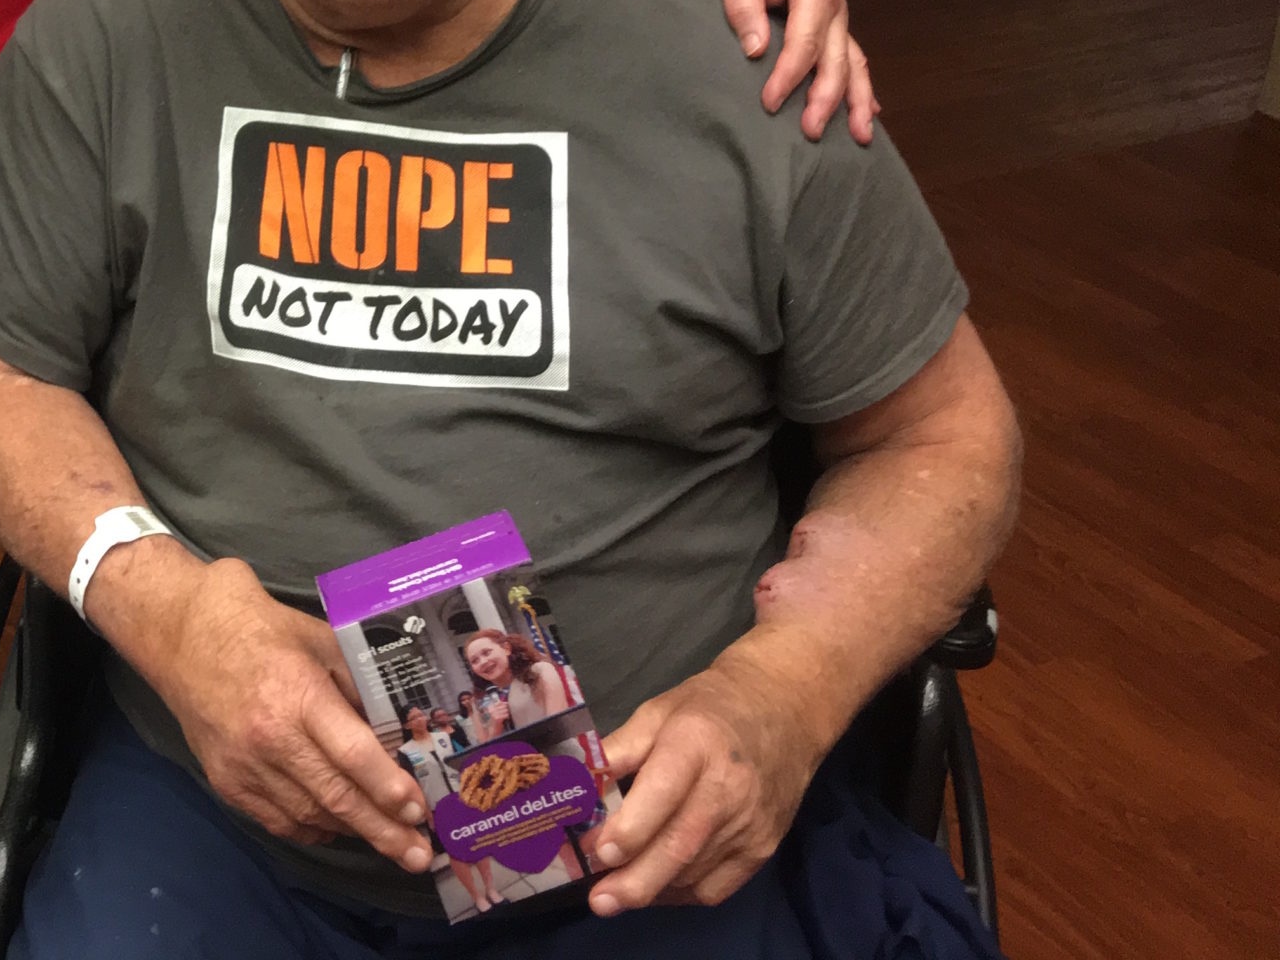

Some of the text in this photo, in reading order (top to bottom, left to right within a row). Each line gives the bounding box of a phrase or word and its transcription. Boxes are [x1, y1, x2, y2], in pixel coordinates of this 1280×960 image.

[258, 142, 514, 274] NOPE
[241, 276, 529, 346] NOT TODAY
[378, 634, 413, 656] scouts
[450, 805, 520, 841] caramel
